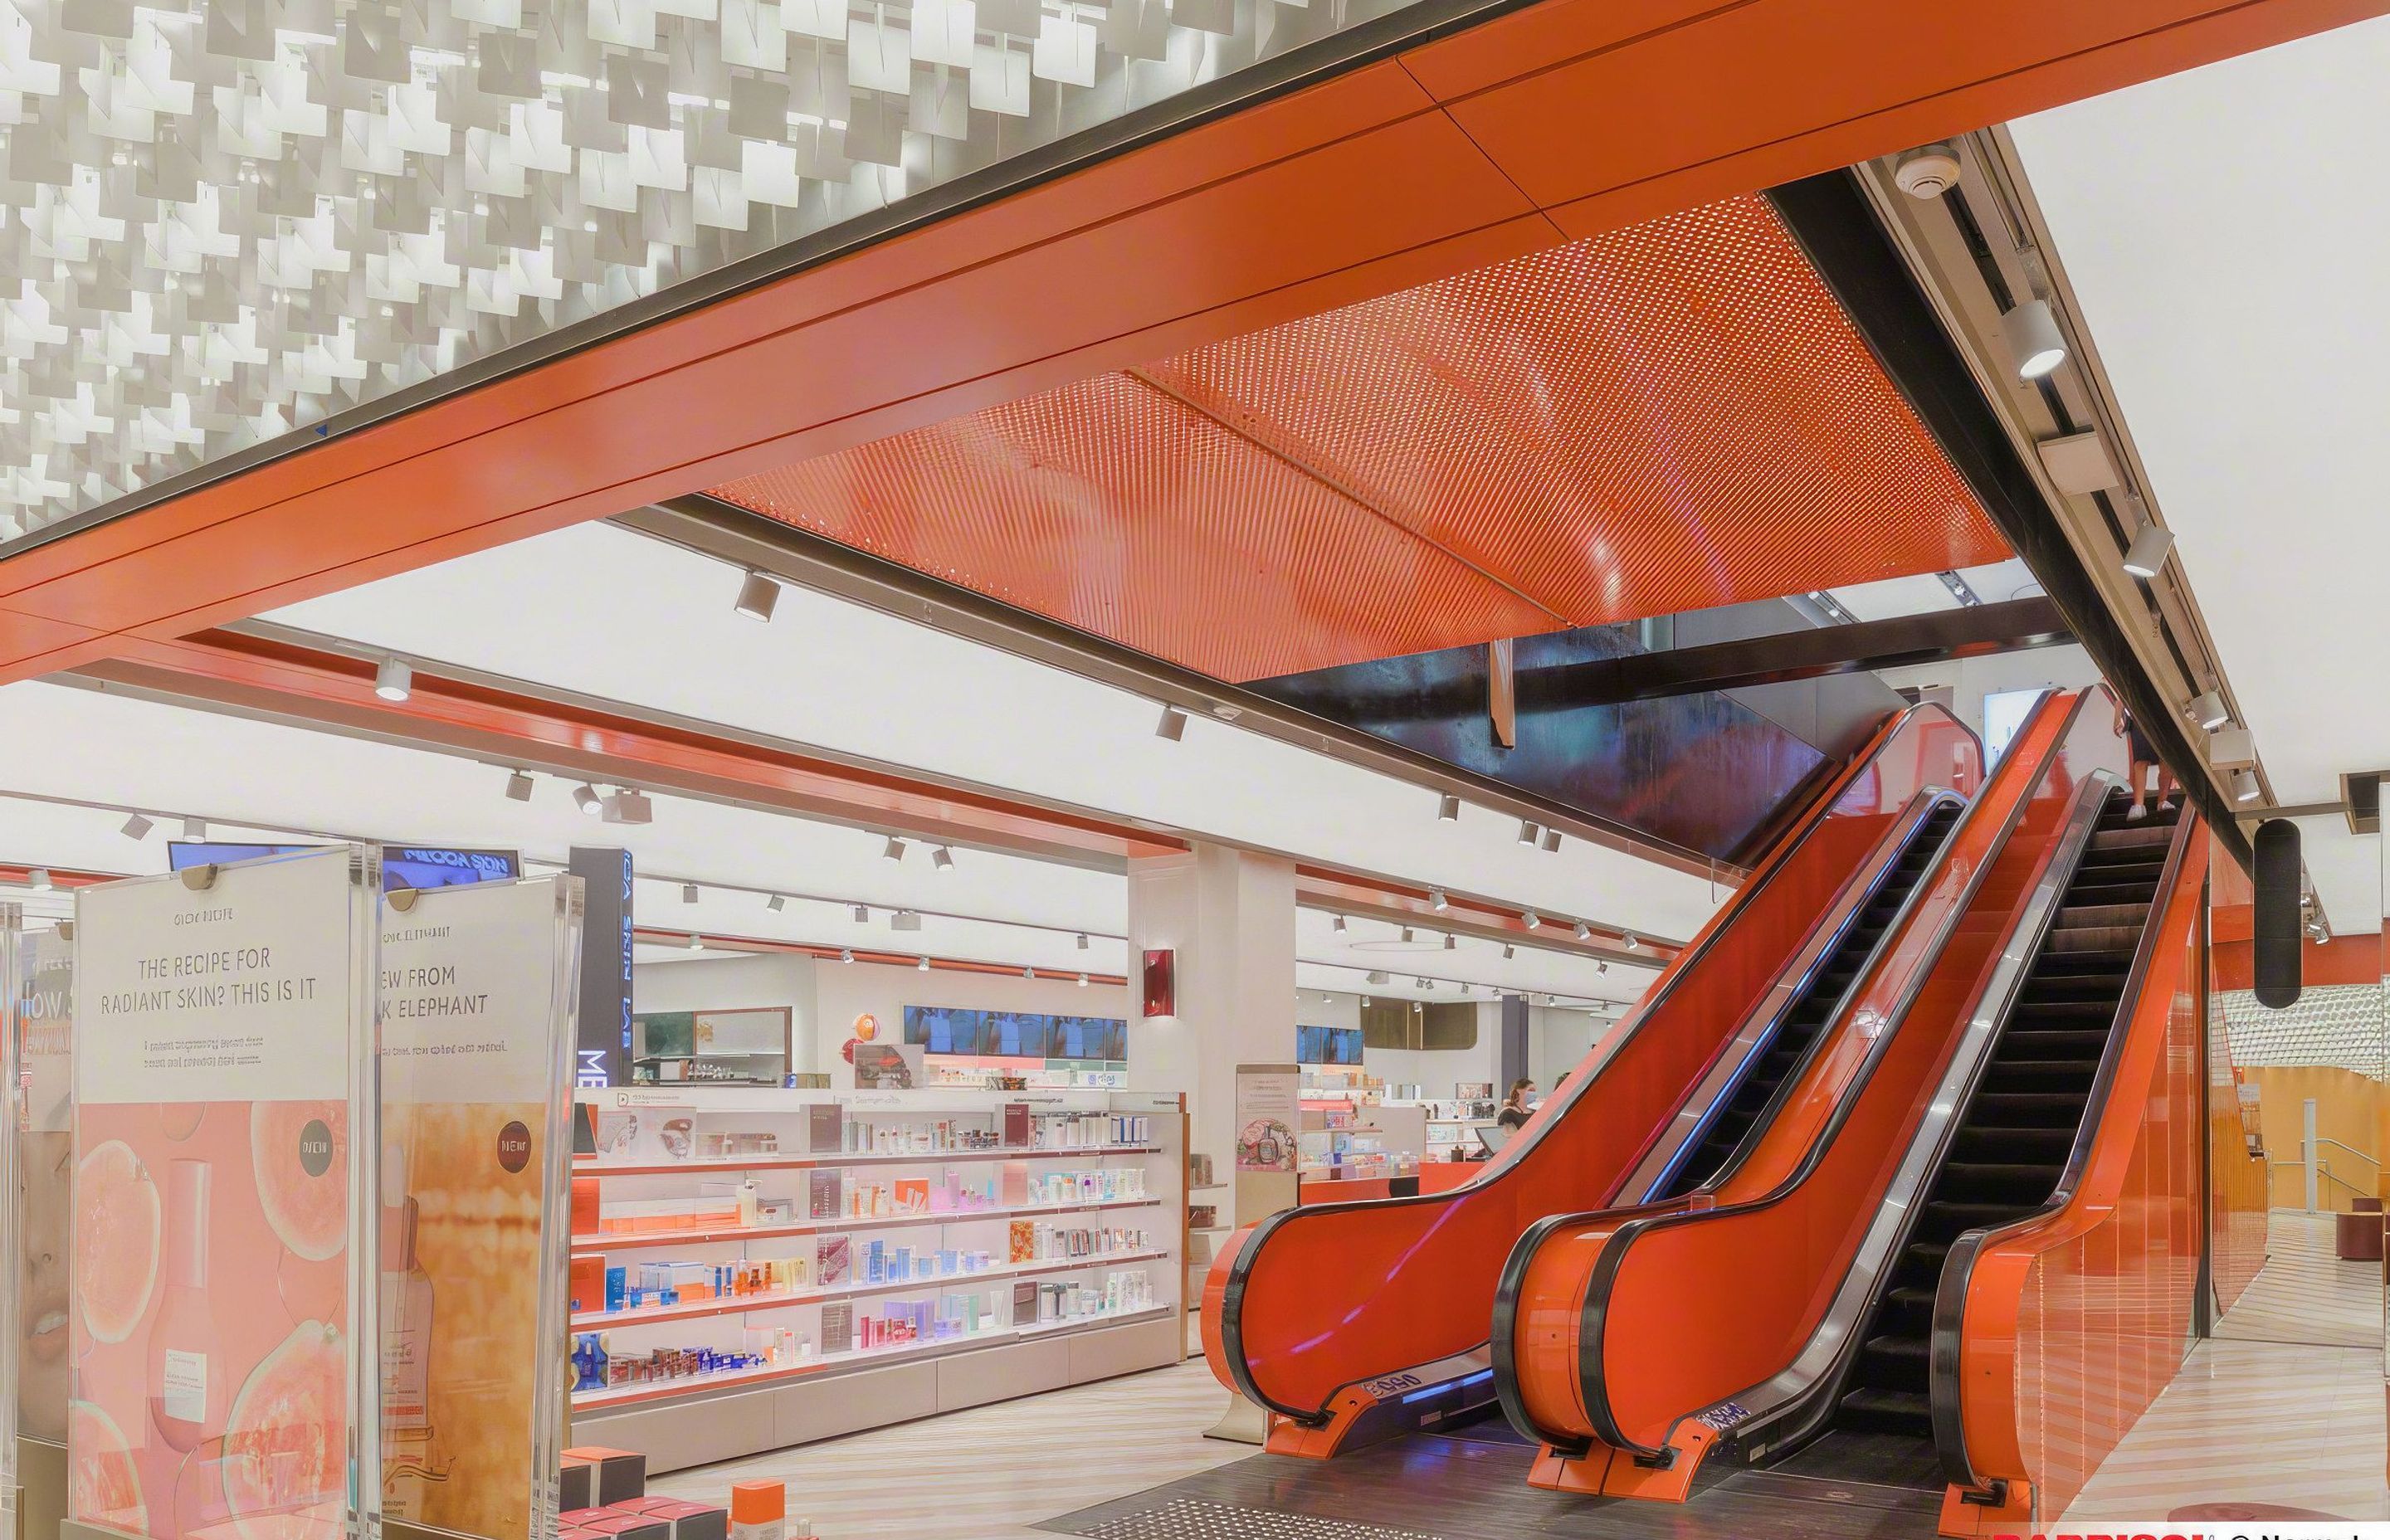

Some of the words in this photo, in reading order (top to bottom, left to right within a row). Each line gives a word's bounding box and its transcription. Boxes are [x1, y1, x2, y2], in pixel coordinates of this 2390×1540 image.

[138, 958, 168, 980] THE
[174, 951, 231, 977] RECIPE
[237, 947, 271, 971] FOR
[408, 965, 455, 988] FROM
[101, 990, 172, 1015] RADIANT
[177, 985, 225, 1009] SKIN?
[231, 982, 270, 1006] THIS
[277, 979, 292, 1001] IS
[300, 977, 317, 1000] IT
[398, 994, 489, 1018] ELEPHANT
